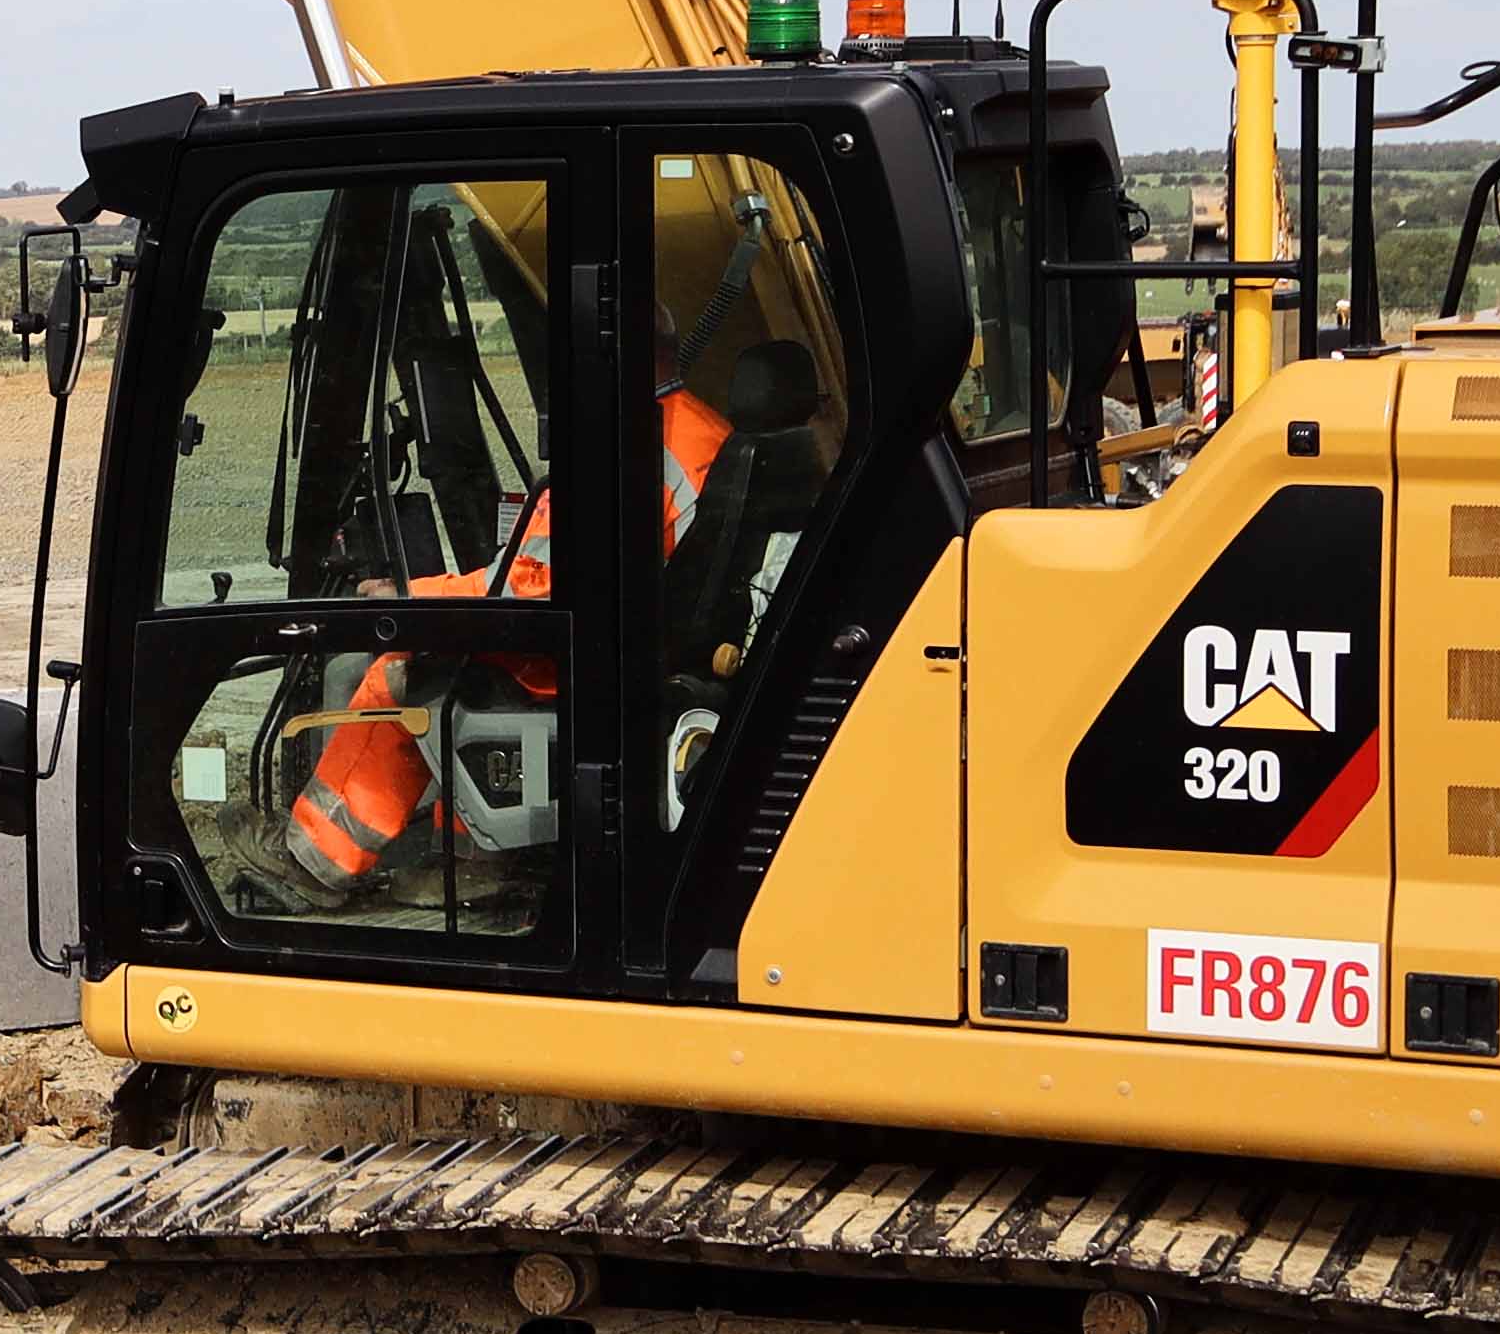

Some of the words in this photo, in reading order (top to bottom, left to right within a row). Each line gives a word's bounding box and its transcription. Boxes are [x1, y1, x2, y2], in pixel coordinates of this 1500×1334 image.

[1183, 625, 1351, 732] CAT
[1183, 747, 1281, 803] 320
[158, 994, 193, 1024] QC
[1159, 947, 1370, 1027] FR876
